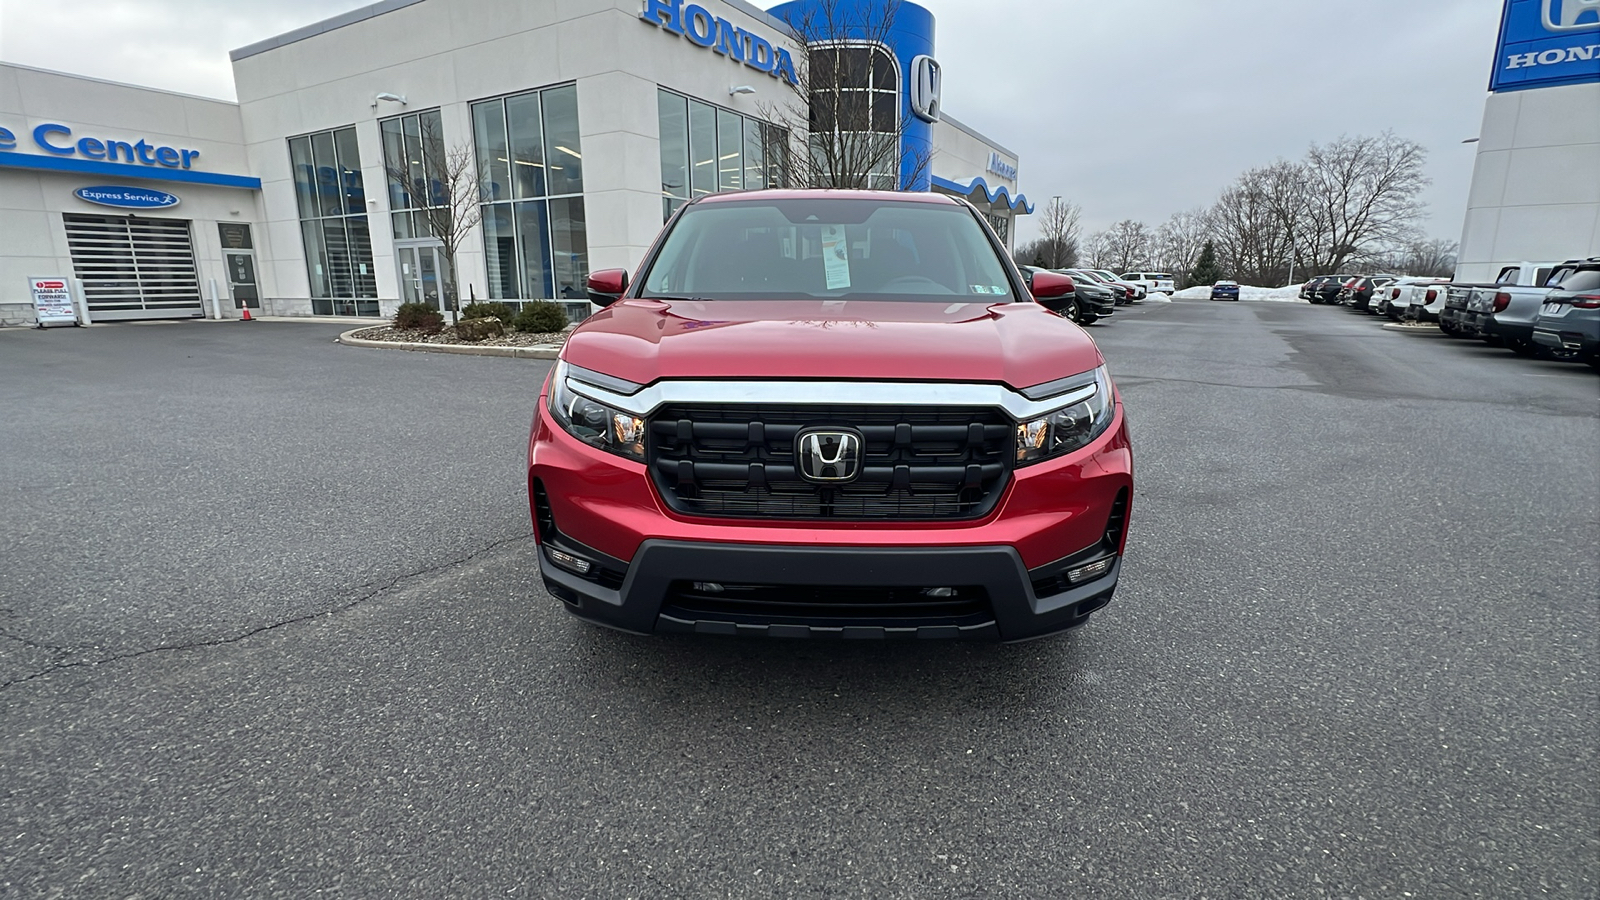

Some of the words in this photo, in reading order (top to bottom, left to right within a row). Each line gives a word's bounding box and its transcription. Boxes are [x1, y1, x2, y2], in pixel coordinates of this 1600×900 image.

[640, 0, 799, 84] HONDA
[1505, 44, 1600, 69] HON
[33, 123, 200, 169] Center
[82, 189, 122, 199] Express
[123, 192, 159, 202] Service
